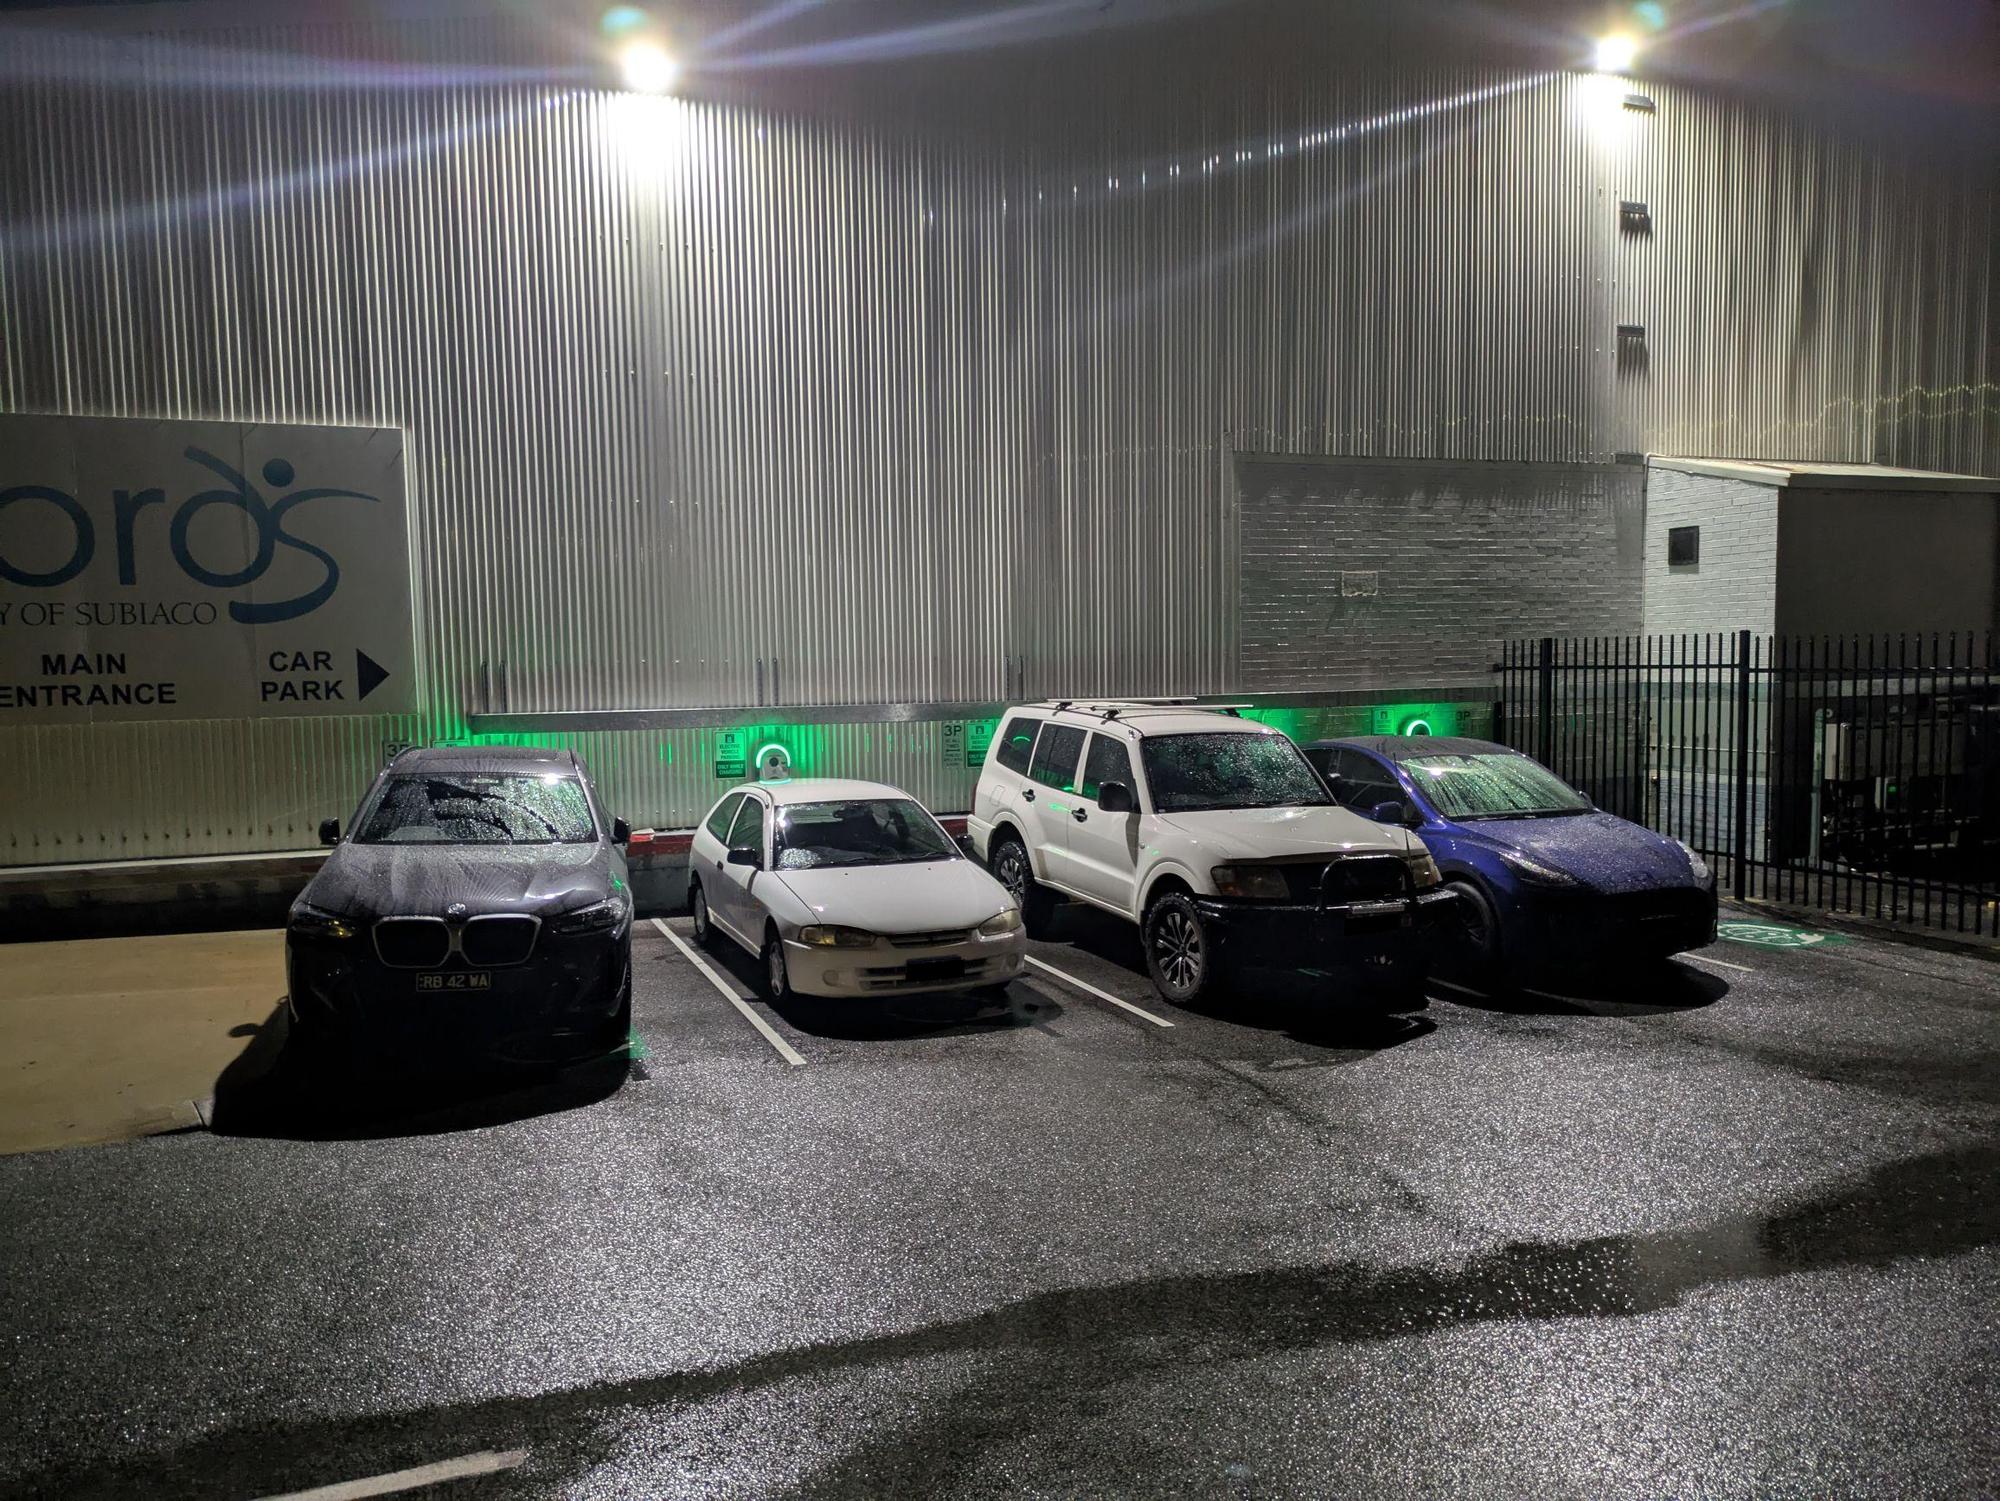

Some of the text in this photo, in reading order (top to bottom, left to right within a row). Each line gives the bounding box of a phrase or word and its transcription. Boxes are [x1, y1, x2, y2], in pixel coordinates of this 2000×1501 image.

[20, 601, 66, 626] OF
[75, 602, 217, 626] SUBIACO
[41, 653, 127, 675] MAIN
[268, 650, 334, 672] CAR
[0, 682, 177, 707] ENTRANCE
[260, 679, 345, 702] PARK
[944, 725, 962, 736] 3P
